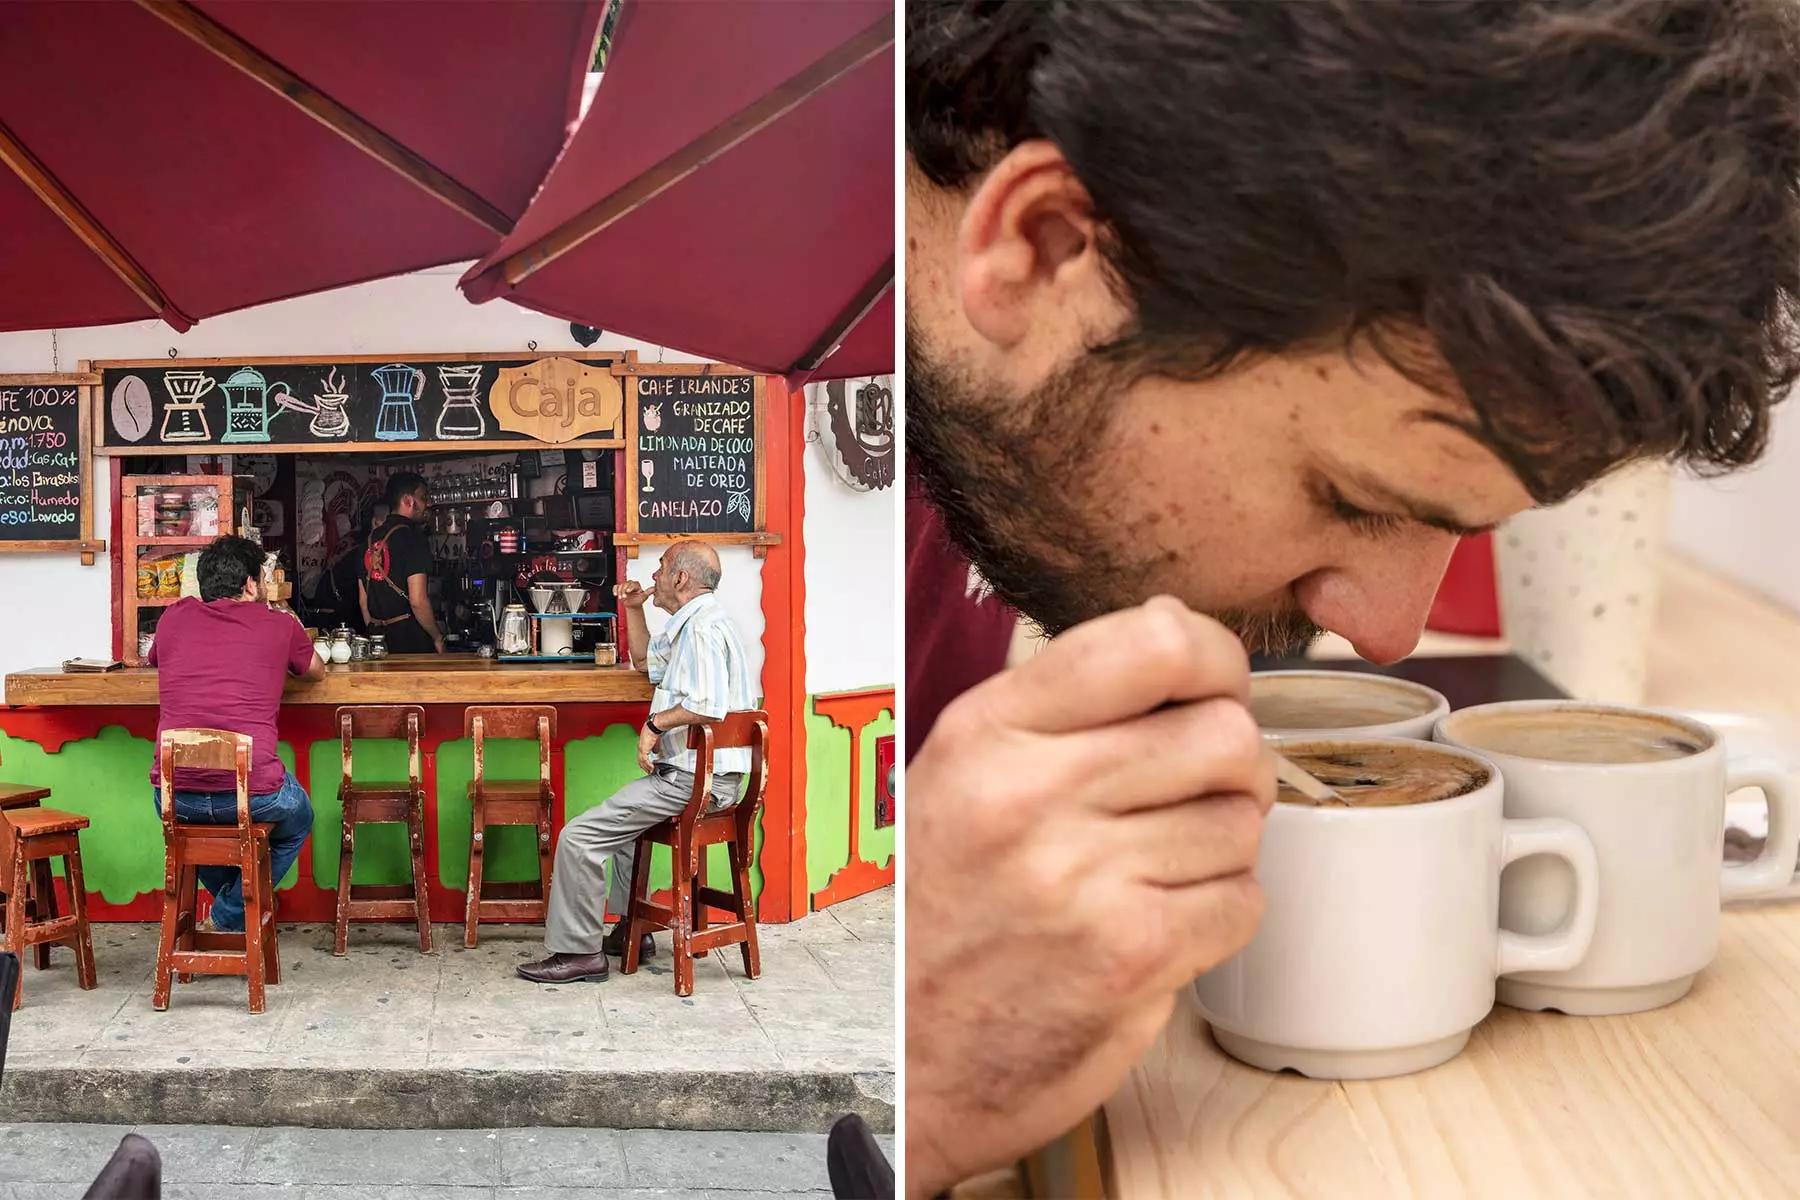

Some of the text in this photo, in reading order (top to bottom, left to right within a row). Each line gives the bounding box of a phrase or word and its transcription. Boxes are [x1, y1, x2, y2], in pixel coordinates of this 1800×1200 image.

[26, 388, 76, 409] 100%
[509, 378, 601, 428] Caja
[673, 400, 750, 417] GRANIZADO
[639, 436, 707, 451] LIMONADA
[673, 455, 746, 472] MALTEADA
[687, 474, 746, 489] DE OREO
[638, 499, 722, 519] CANELAZO
